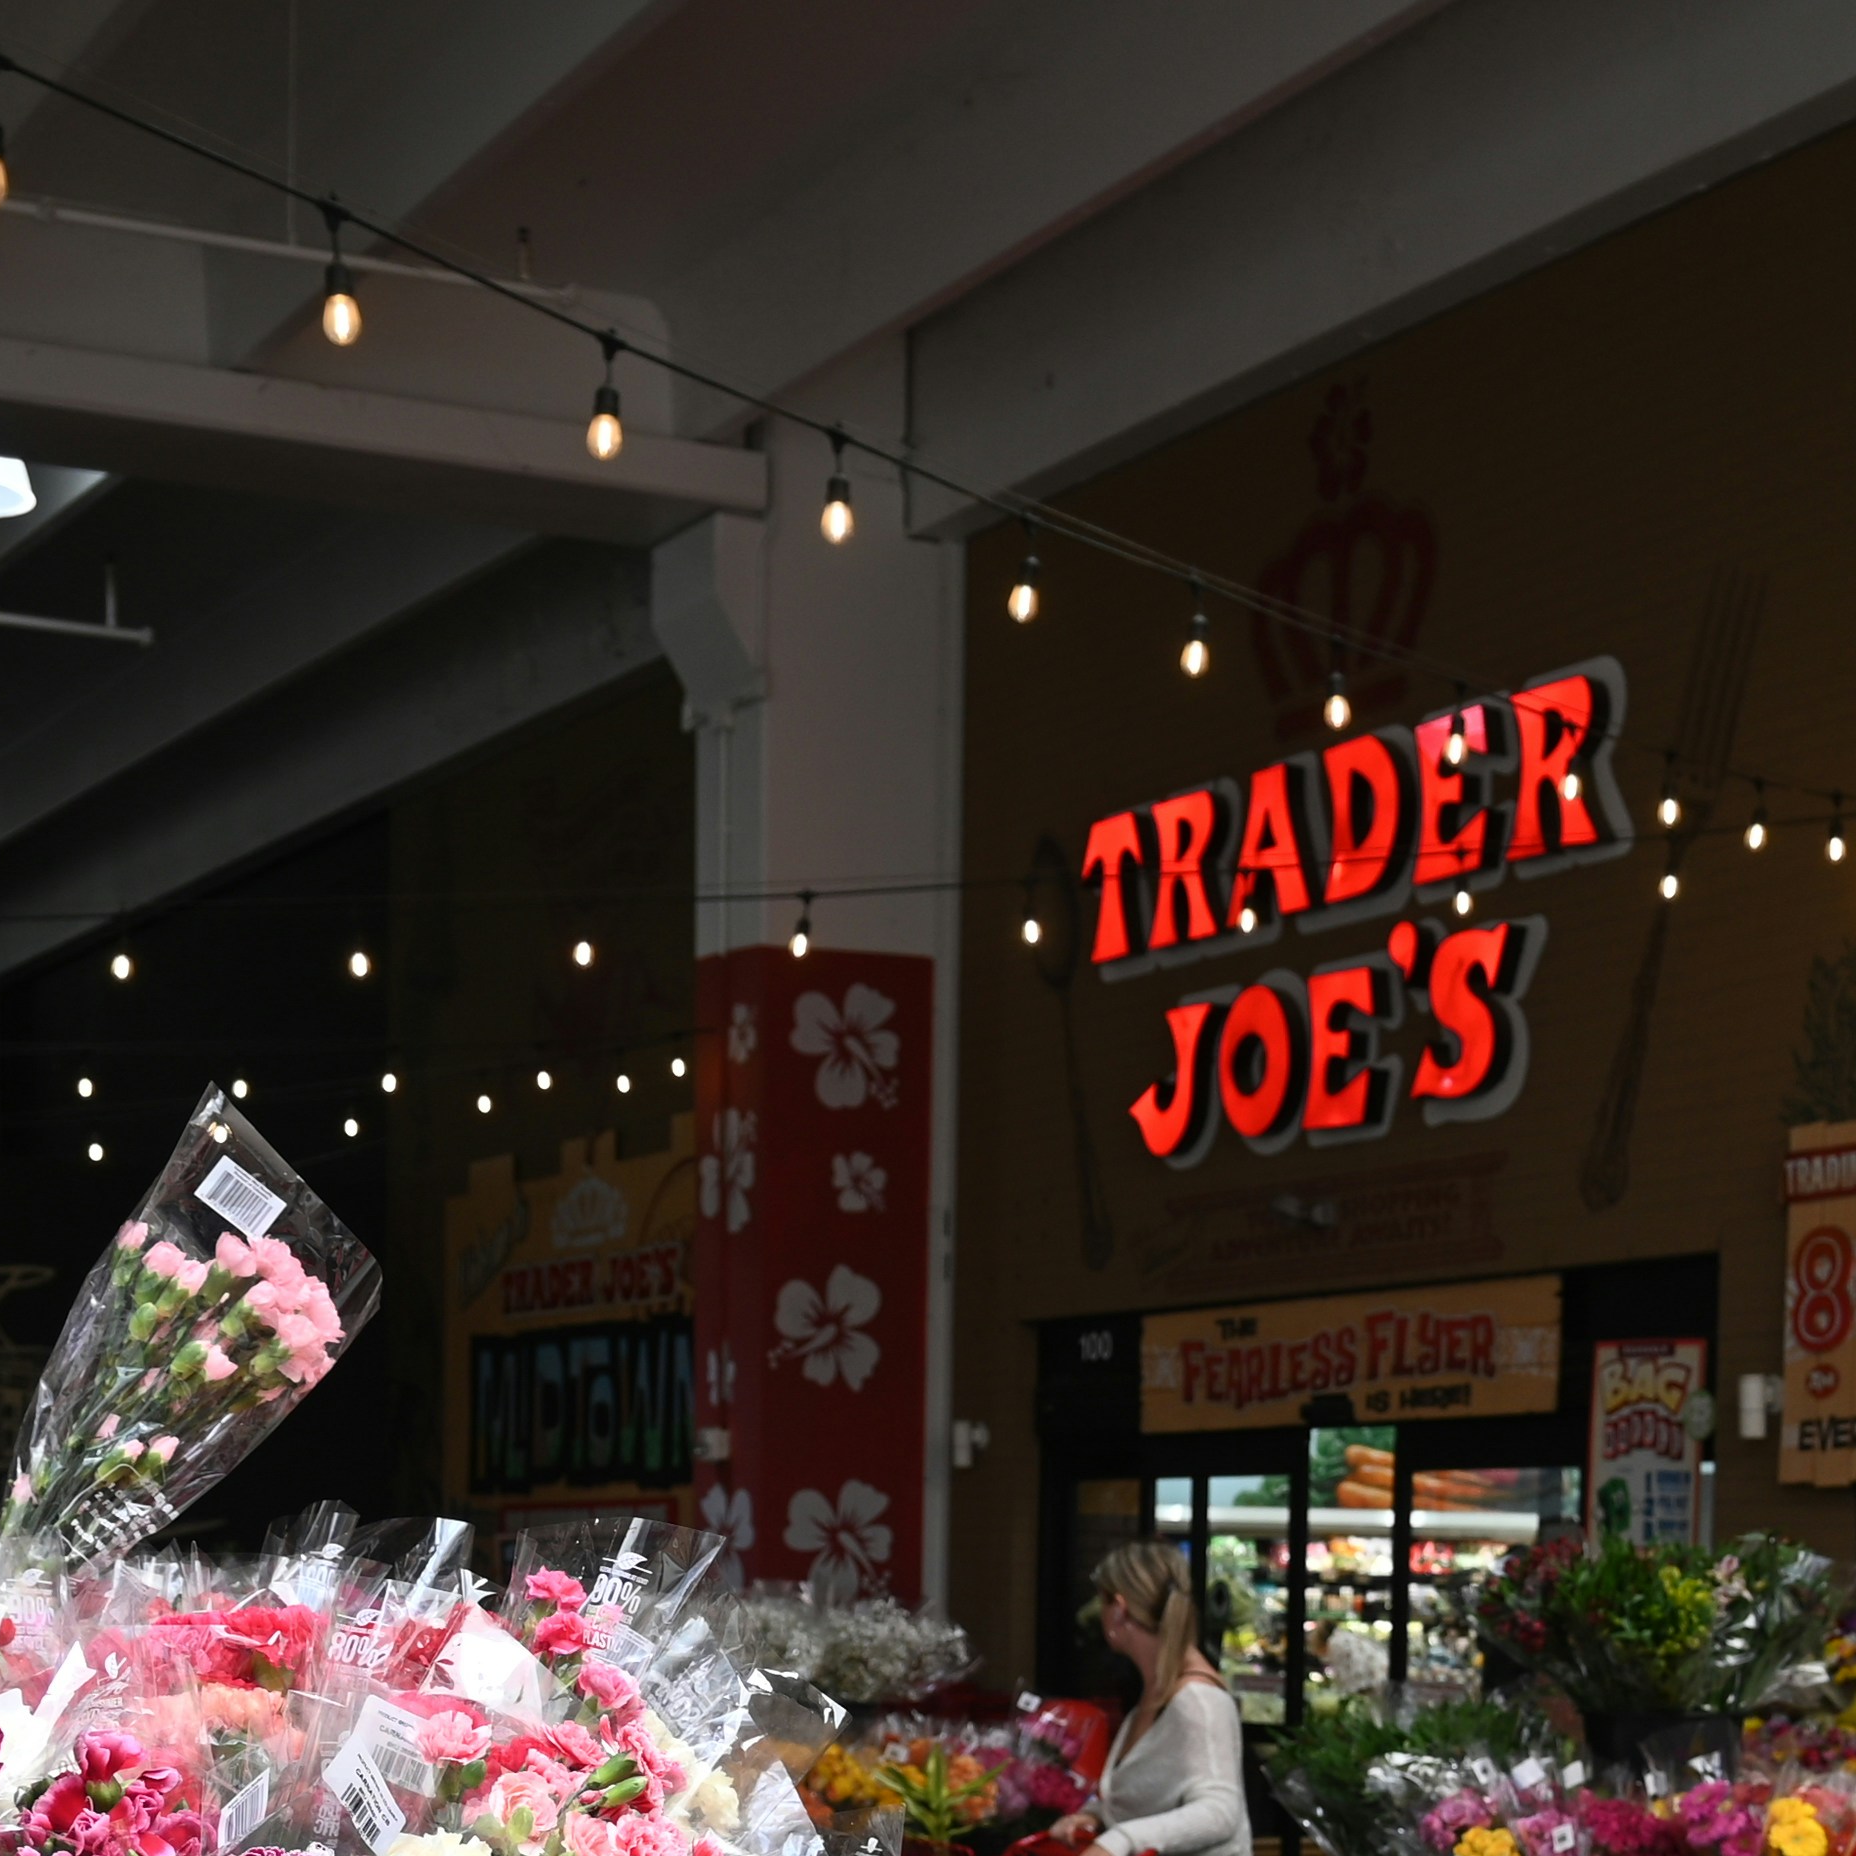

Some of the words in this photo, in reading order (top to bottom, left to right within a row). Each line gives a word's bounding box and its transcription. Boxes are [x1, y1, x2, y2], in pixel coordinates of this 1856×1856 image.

[1081, 675, 1600, 964] TRADER
[1129, 920, 1511, 1158] JOE'S
[502, 1261, 594, 1314] TRADER
[605, 1247, 679, 1302] JOE'S
[1793, 1226, 1853, 1351] 8
[1078, 1331, 1113, 1362] 100
[1180, 1327, 1357, 1410] FEARLESS
[1366, 1310, 1496, 1379] FLYER
[1602, 1360, 1689, 1413] BAG
[355, 1768, 382, 1814] CARNATION
[381, 1813, 391, 1827] CB
